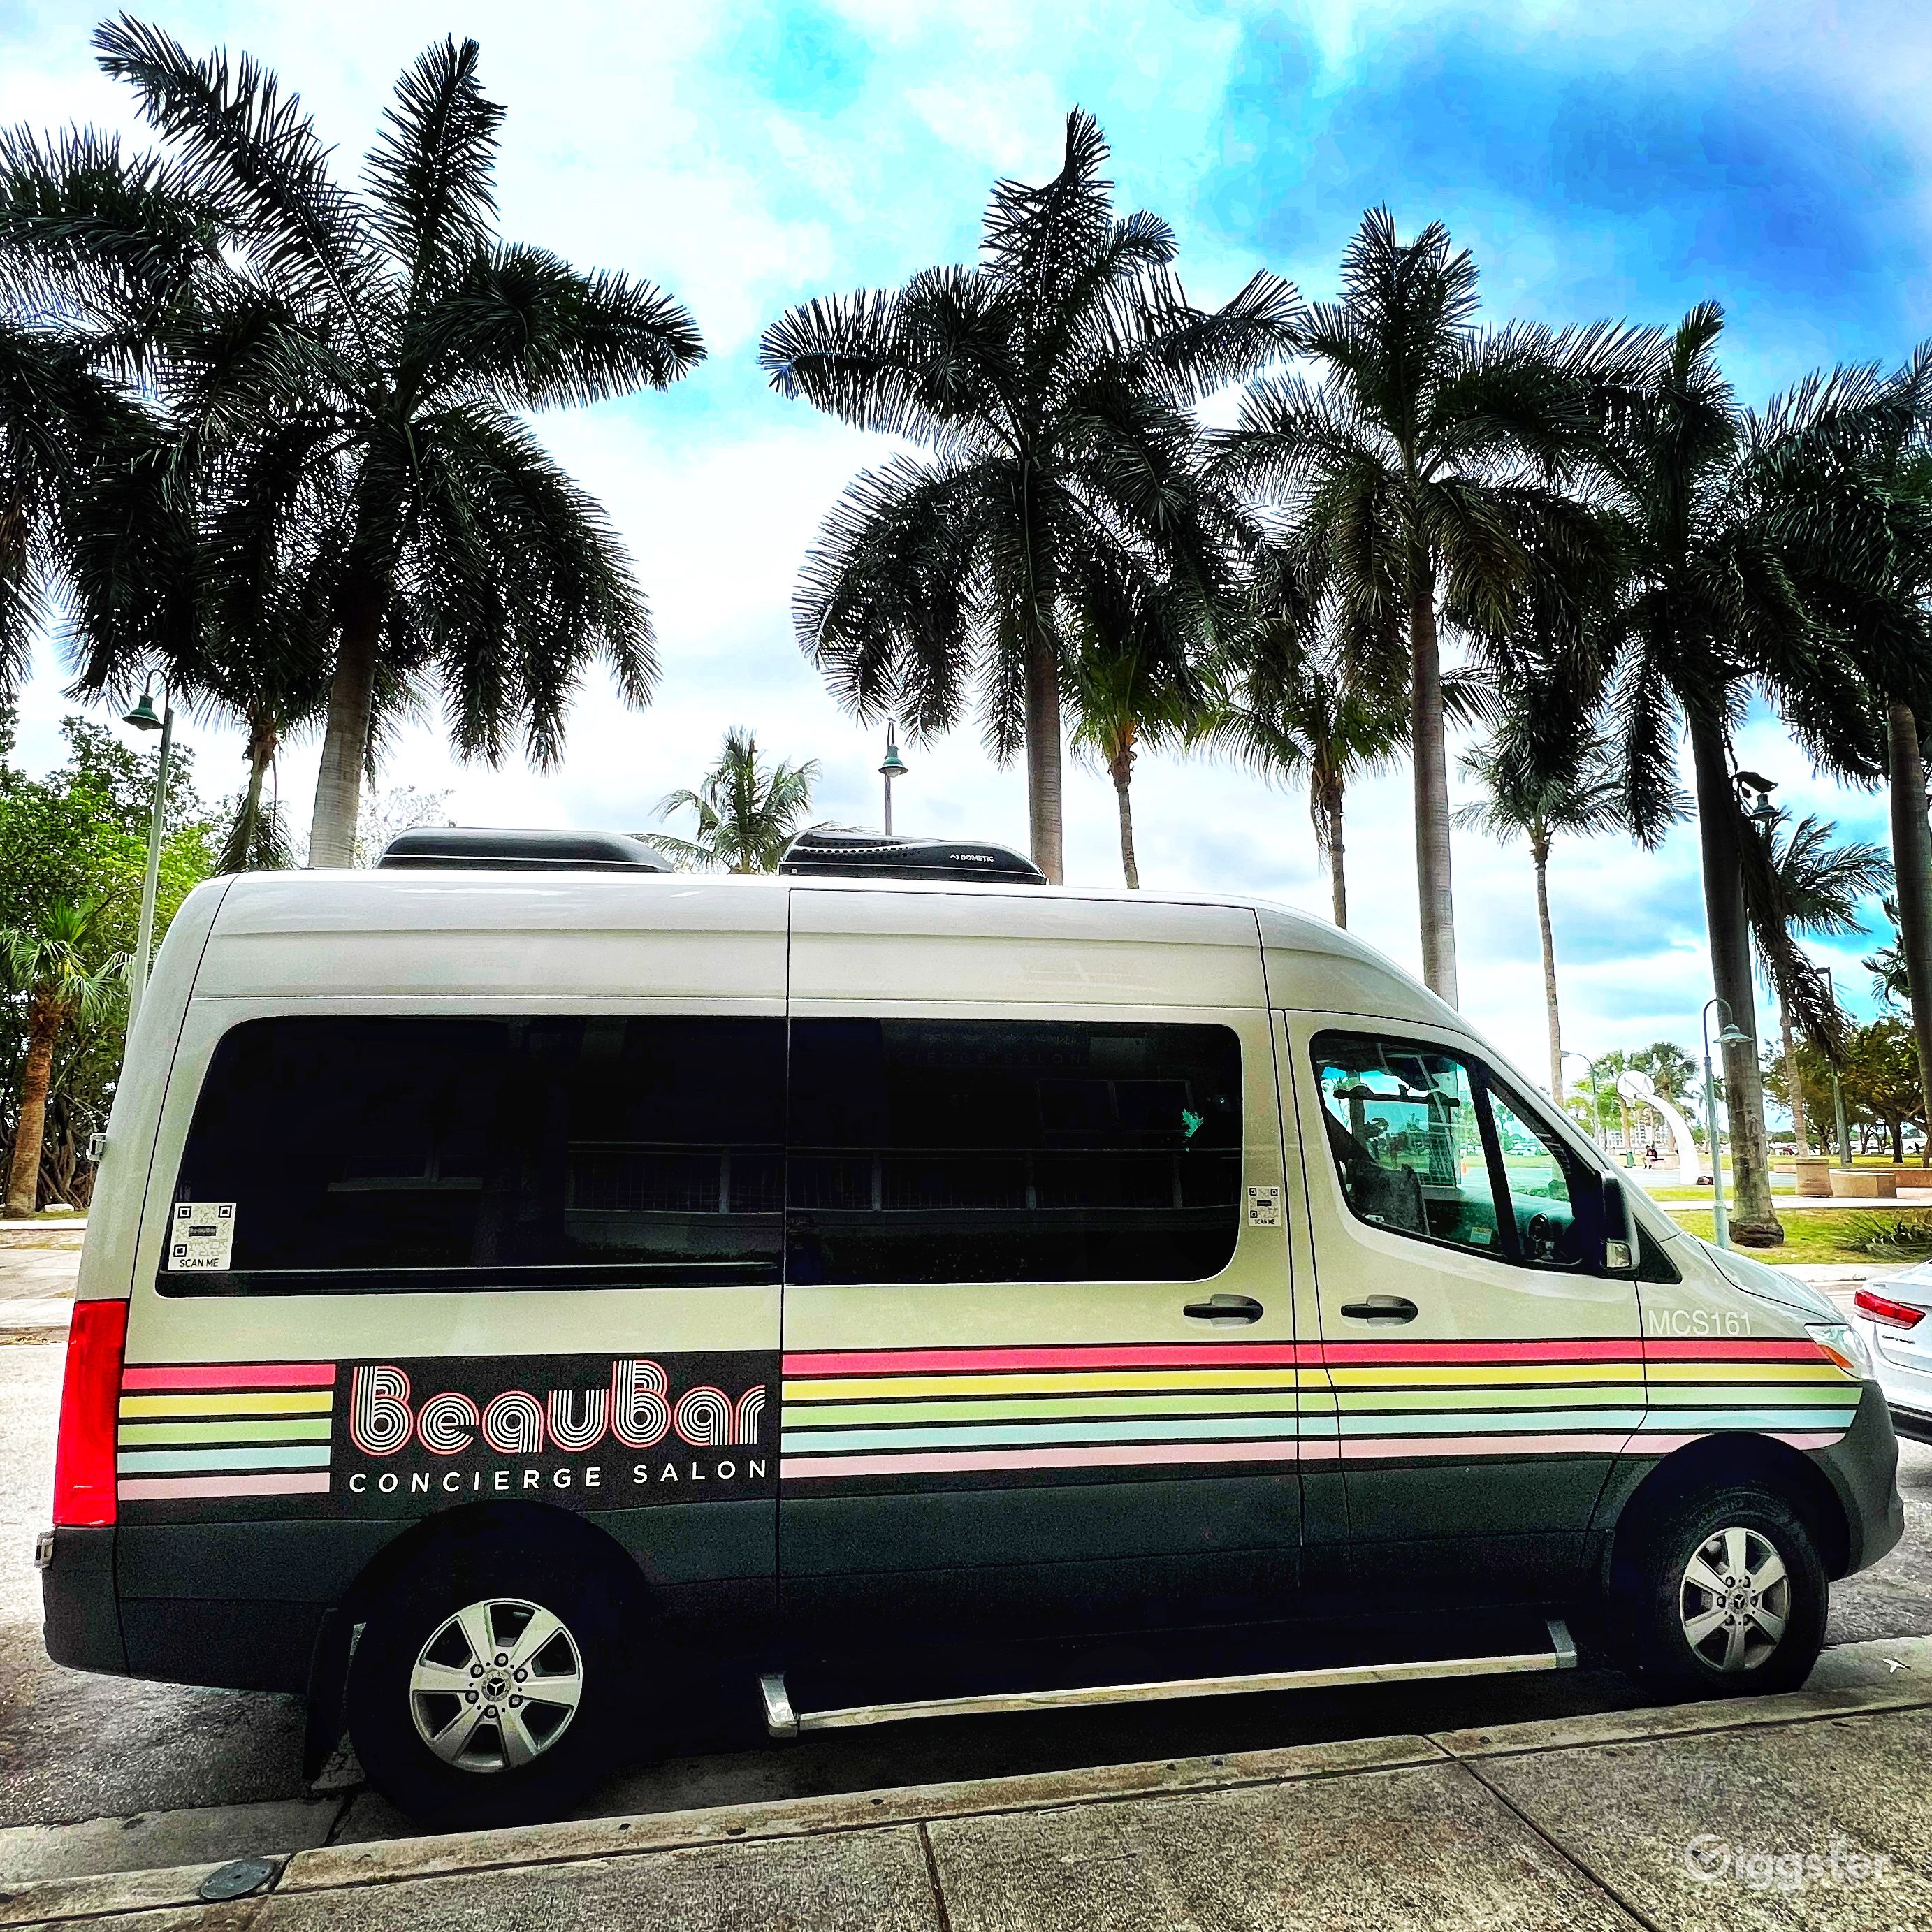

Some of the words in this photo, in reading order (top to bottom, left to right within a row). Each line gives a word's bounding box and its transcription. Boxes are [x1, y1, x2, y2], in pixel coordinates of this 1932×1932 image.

[960, 854, 994, 862] DOMETIC
[179, 1258, 204, 1268] SCAN
[205, 1258, 219, 1268] ME
[1648, 1309, 1751, 1336] MCS161
[349, 1467, 601, 1493] CONCIERGE
[632, 1460, 766, 1483] SALON
